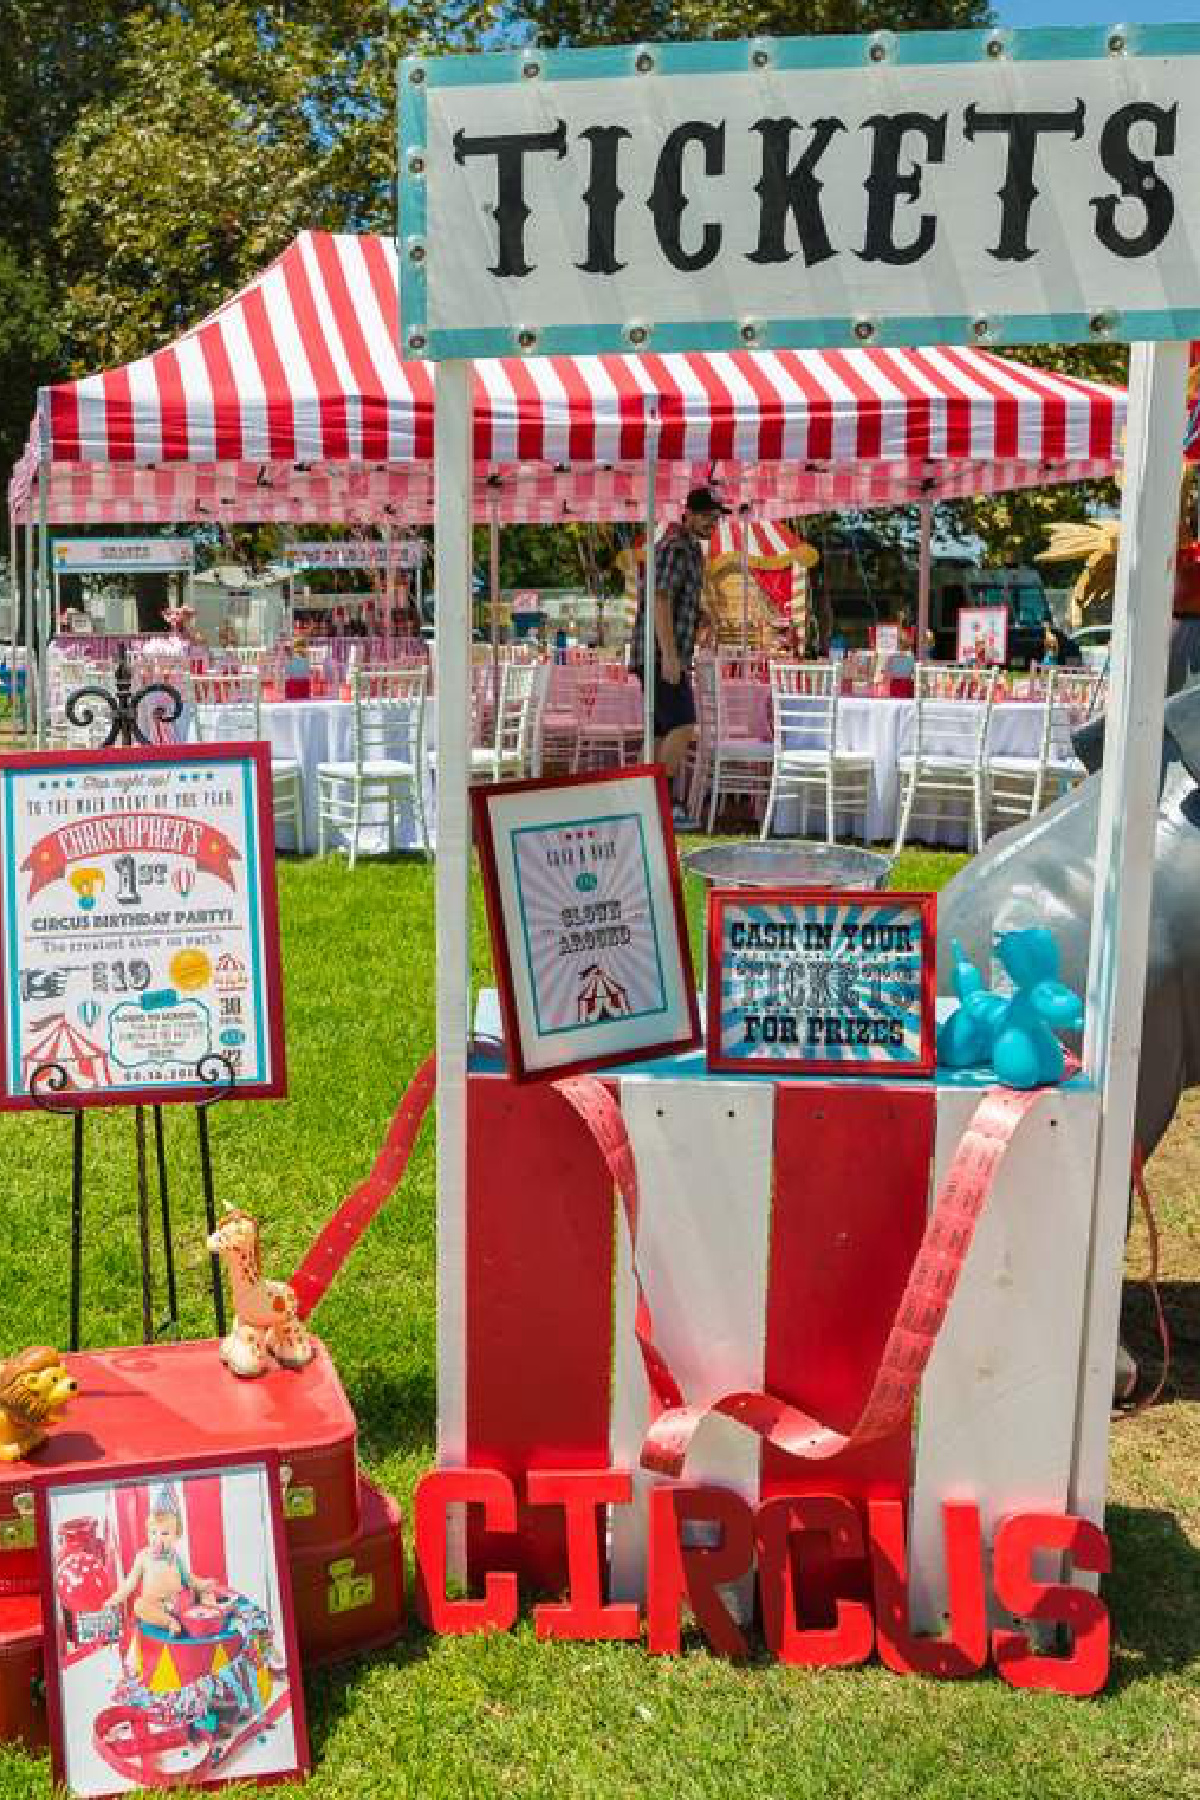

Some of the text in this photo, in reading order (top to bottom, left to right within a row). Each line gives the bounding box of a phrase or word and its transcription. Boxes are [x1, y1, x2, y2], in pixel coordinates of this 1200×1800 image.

[453, 97, 1179, 277] TICKETS
[58, 815, 202, 856] CHRISTOPHER'S
[31, 909, 233, 932] CIRCUS BIRTHDAY PARTY!
[731, 922, 914, 952] CASH IN YOUR
[732, 960, 917, 1007] TICKETS
[744, 1016, 904, 1046] FOR PRIZES
[414, 1466, 1111, 1698] CIRCUS
